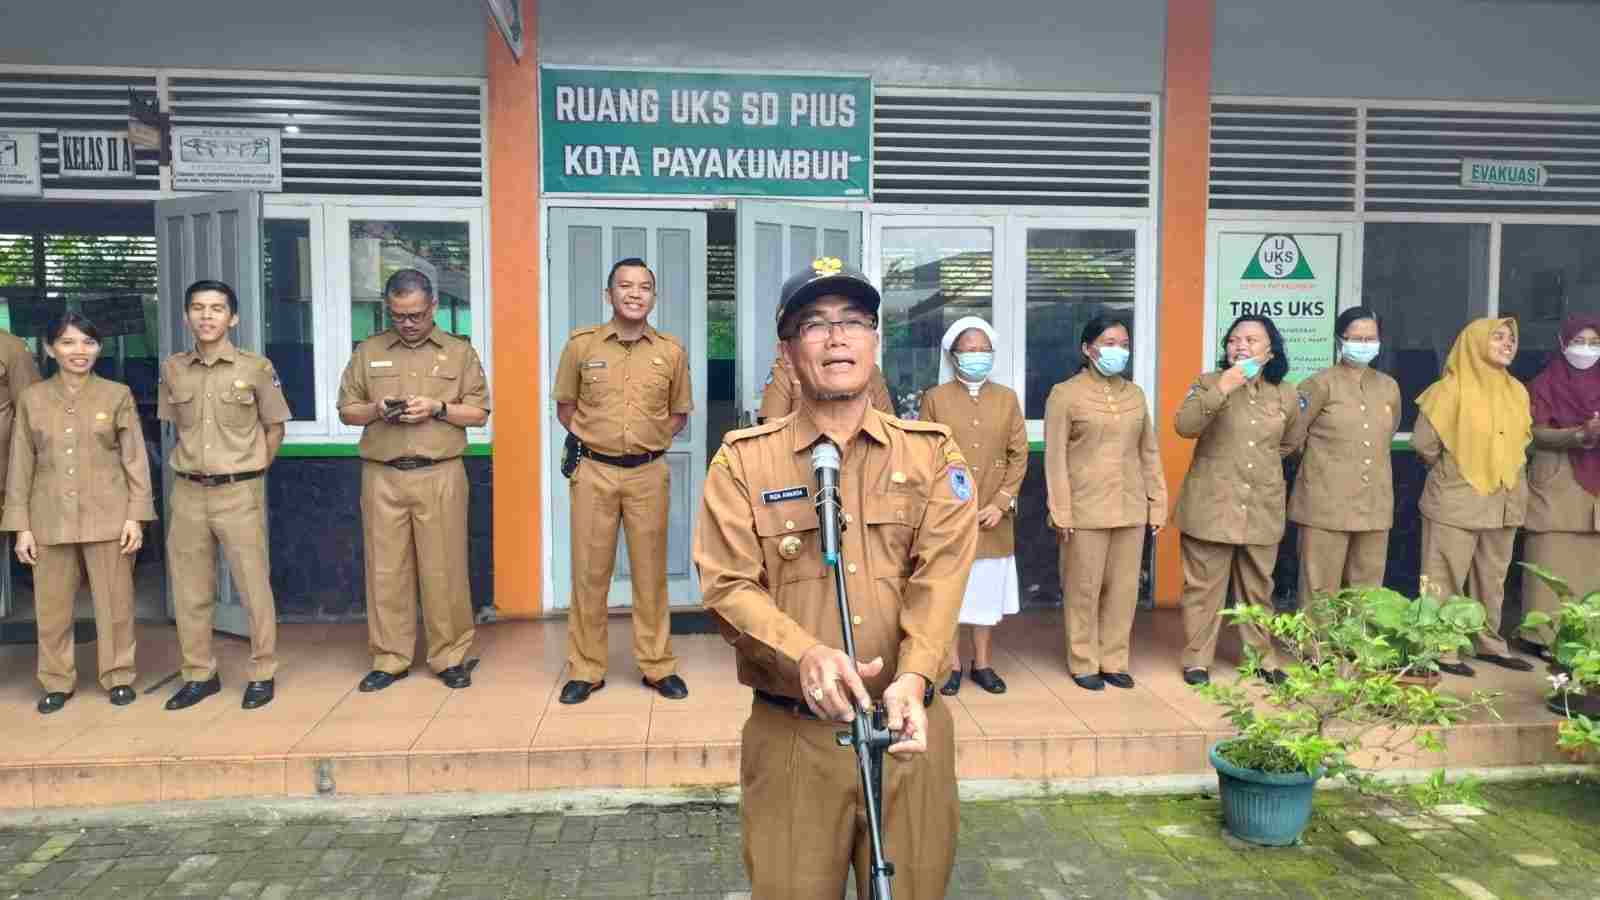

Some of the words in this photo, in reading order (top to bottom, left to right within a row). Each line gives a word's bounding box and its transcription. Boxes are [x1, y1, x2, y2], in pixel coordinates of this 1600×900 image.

[555, 86, 659, 123] RUANG
[671, 89, 730, 125] UKS
[741, 92, 779, 127] SD
[790, 93, 856, 128] PIUS
[62, 135, 104, 171] KELAS
[106, 137, 119, 171] II
[121, 137, 132, 172] A
[564, 145, 641, 176] KOTA
[652, 147, 849, 180] PAYAKUMBUH
[1471, 164, 1540, 184] EVAKUASI
[1264, 250, 1293, 263] UKS
[1230, 301, 1283, 317] TRIAS
[1288, 301, 1325, 317] UKS
